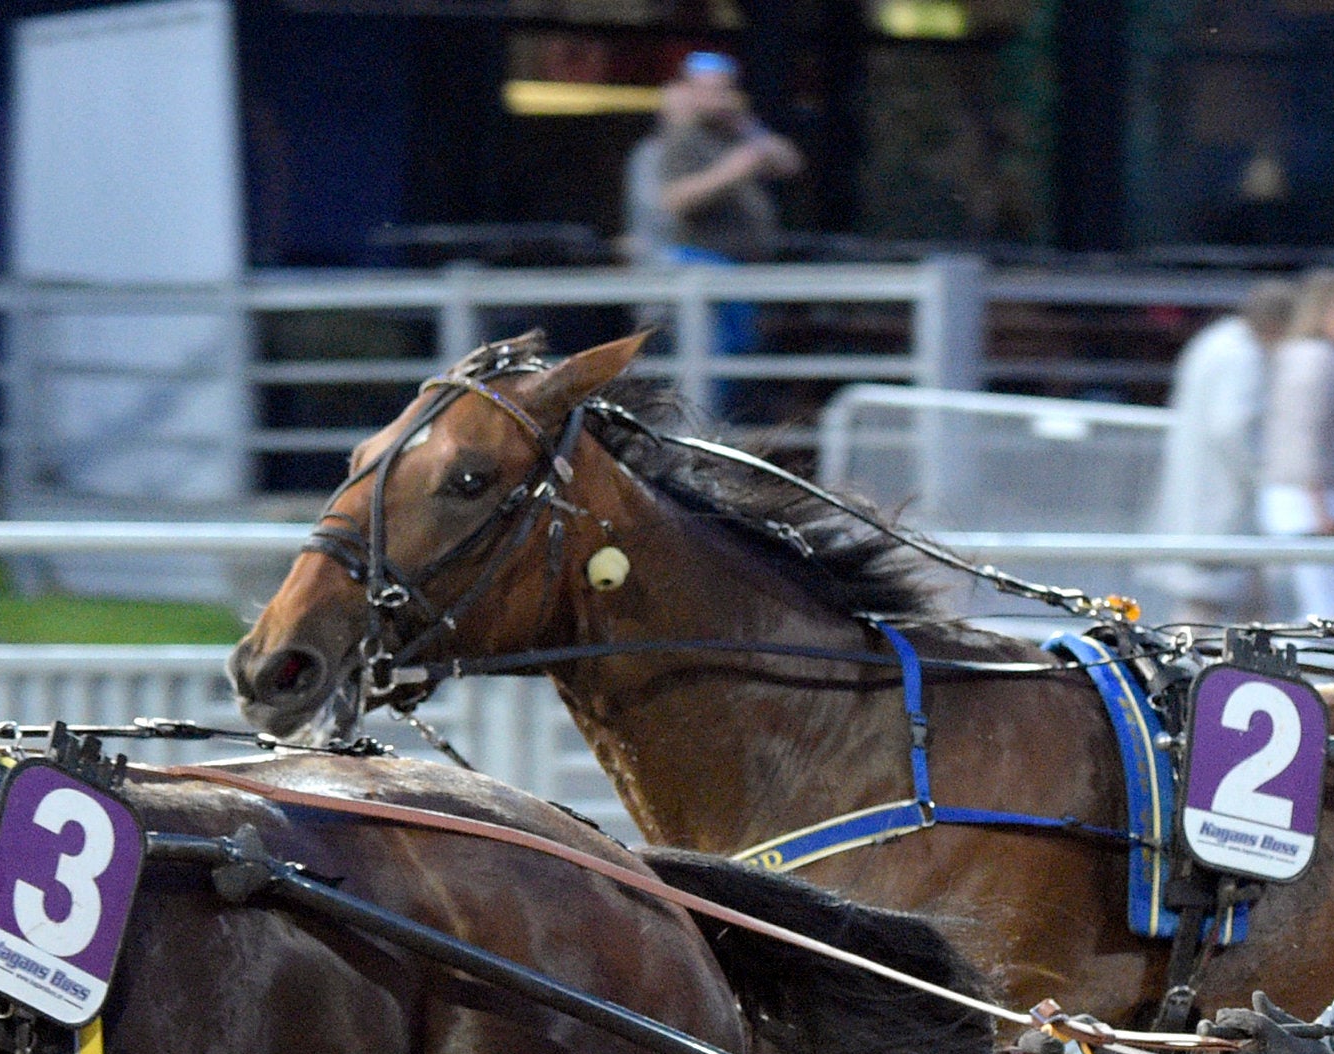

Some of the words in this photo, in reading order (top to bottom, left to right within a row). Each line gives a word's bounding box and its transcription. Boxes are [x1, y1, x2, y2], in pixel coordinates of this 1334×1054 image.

[1211, 681, 1302, 829] 2
[13, 787, 115, 957] 3
[1200, 822, 1259, 846] Kagans
